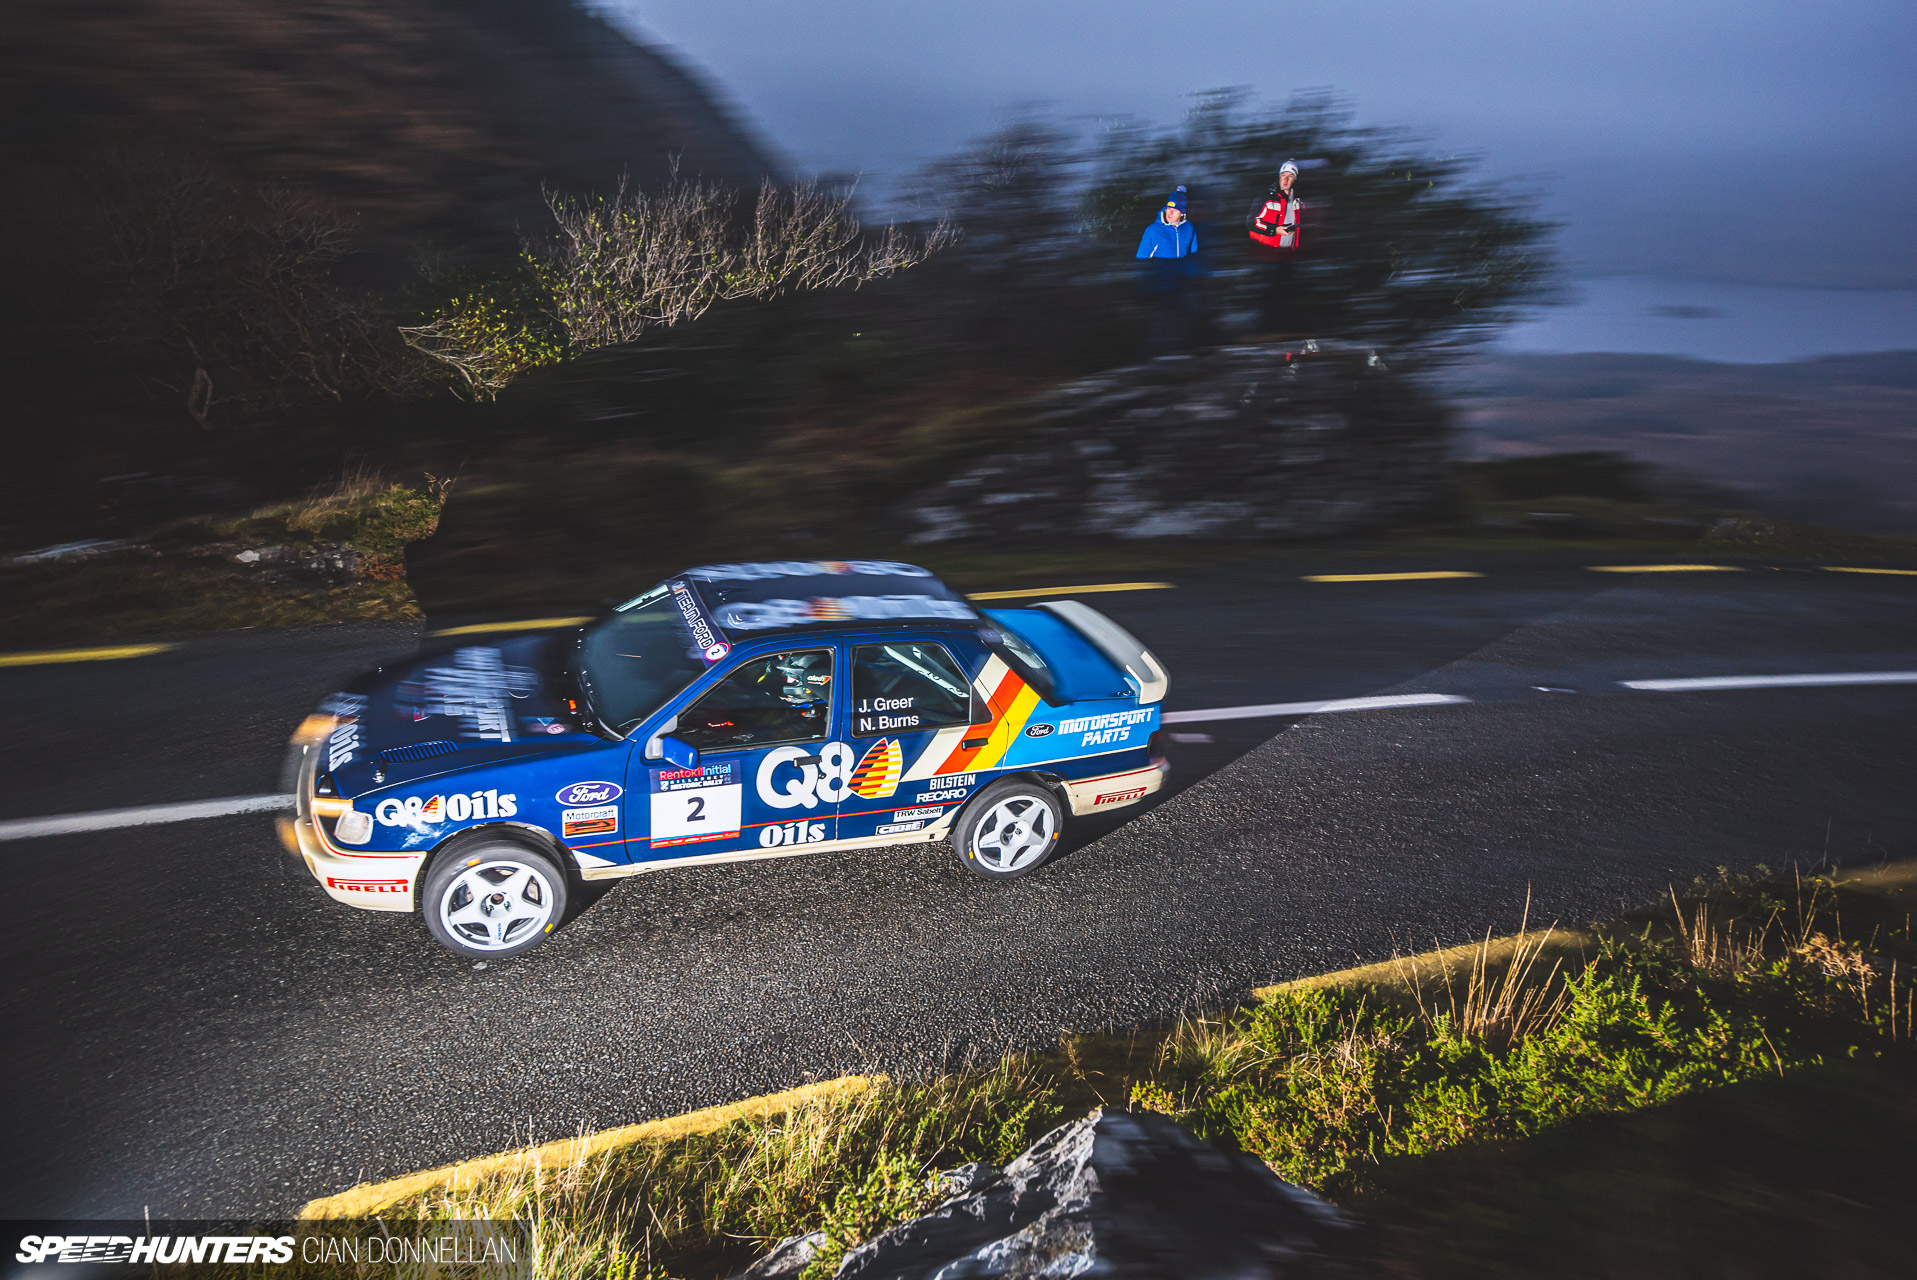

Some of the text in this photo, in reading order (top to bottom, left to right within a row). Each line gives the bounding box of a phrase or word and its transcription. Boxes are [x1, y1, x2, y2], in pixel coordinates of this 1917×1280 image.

[675, 589, 701, 627] TEAM
[691, 617, 716, 650] FORD
[711, 648, 720, 656] 2
[858, 696, 914, 714] J. Greer
[860, 715, 920, 732] N. Burns
[1030, 724, 1050, 736] Ford
[1058, 707, 1155, 735] MOTORSPORT
[1081, 726, 1131, 747] PARTS
[756, 741, 855, 809] Q8
[929, 773, 976, 790] BILSTEIN
[568, 784, 610, 804] Ford
[916, 788, 967, 803] RECARO
[1093, 786, 1147, 805] PIRELLI
[375, 788, 518, 827] Q8 Oils
[566, 809, 614, 821] Motorcraft
[686, 796, 706, 822] 2
[895, 807, 942, 819] TRW Sabelt
[759, 820, 826, 848] Oils
[326, 876, 409, 893] PIRELLI
